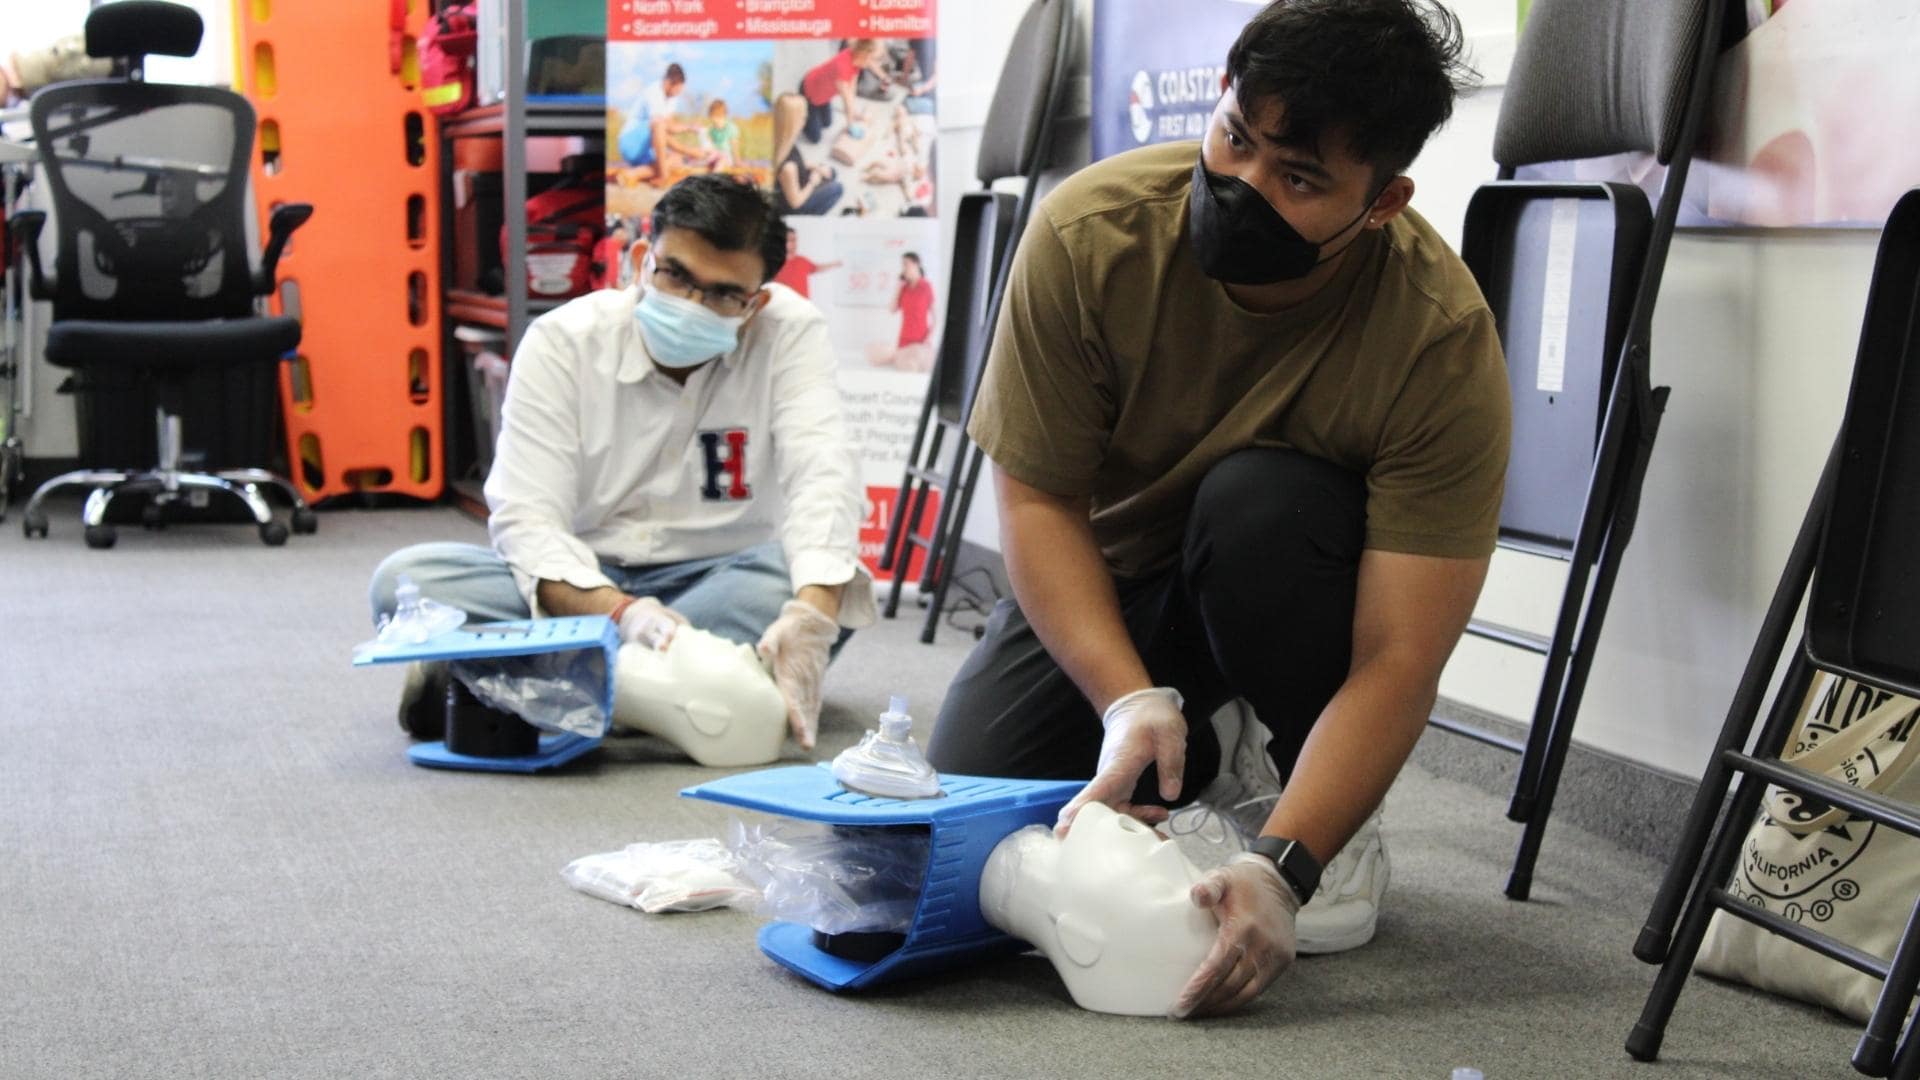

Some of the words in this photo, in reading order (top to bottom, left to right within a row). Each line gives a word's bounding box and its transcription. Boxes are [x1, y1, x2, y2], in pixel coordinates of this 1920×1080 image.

[673, 0, 704, 14] York
[633, 19, 718, 37] Scarborough
[745, 17, 832, 35] Mississauga
[1158, 114, 1184, 137] FIRST
[1186, 112, 1204, 135] AID
[698, 429, 751, 501] H
[1749, 838, 1833, 880] CALIFORNIA
